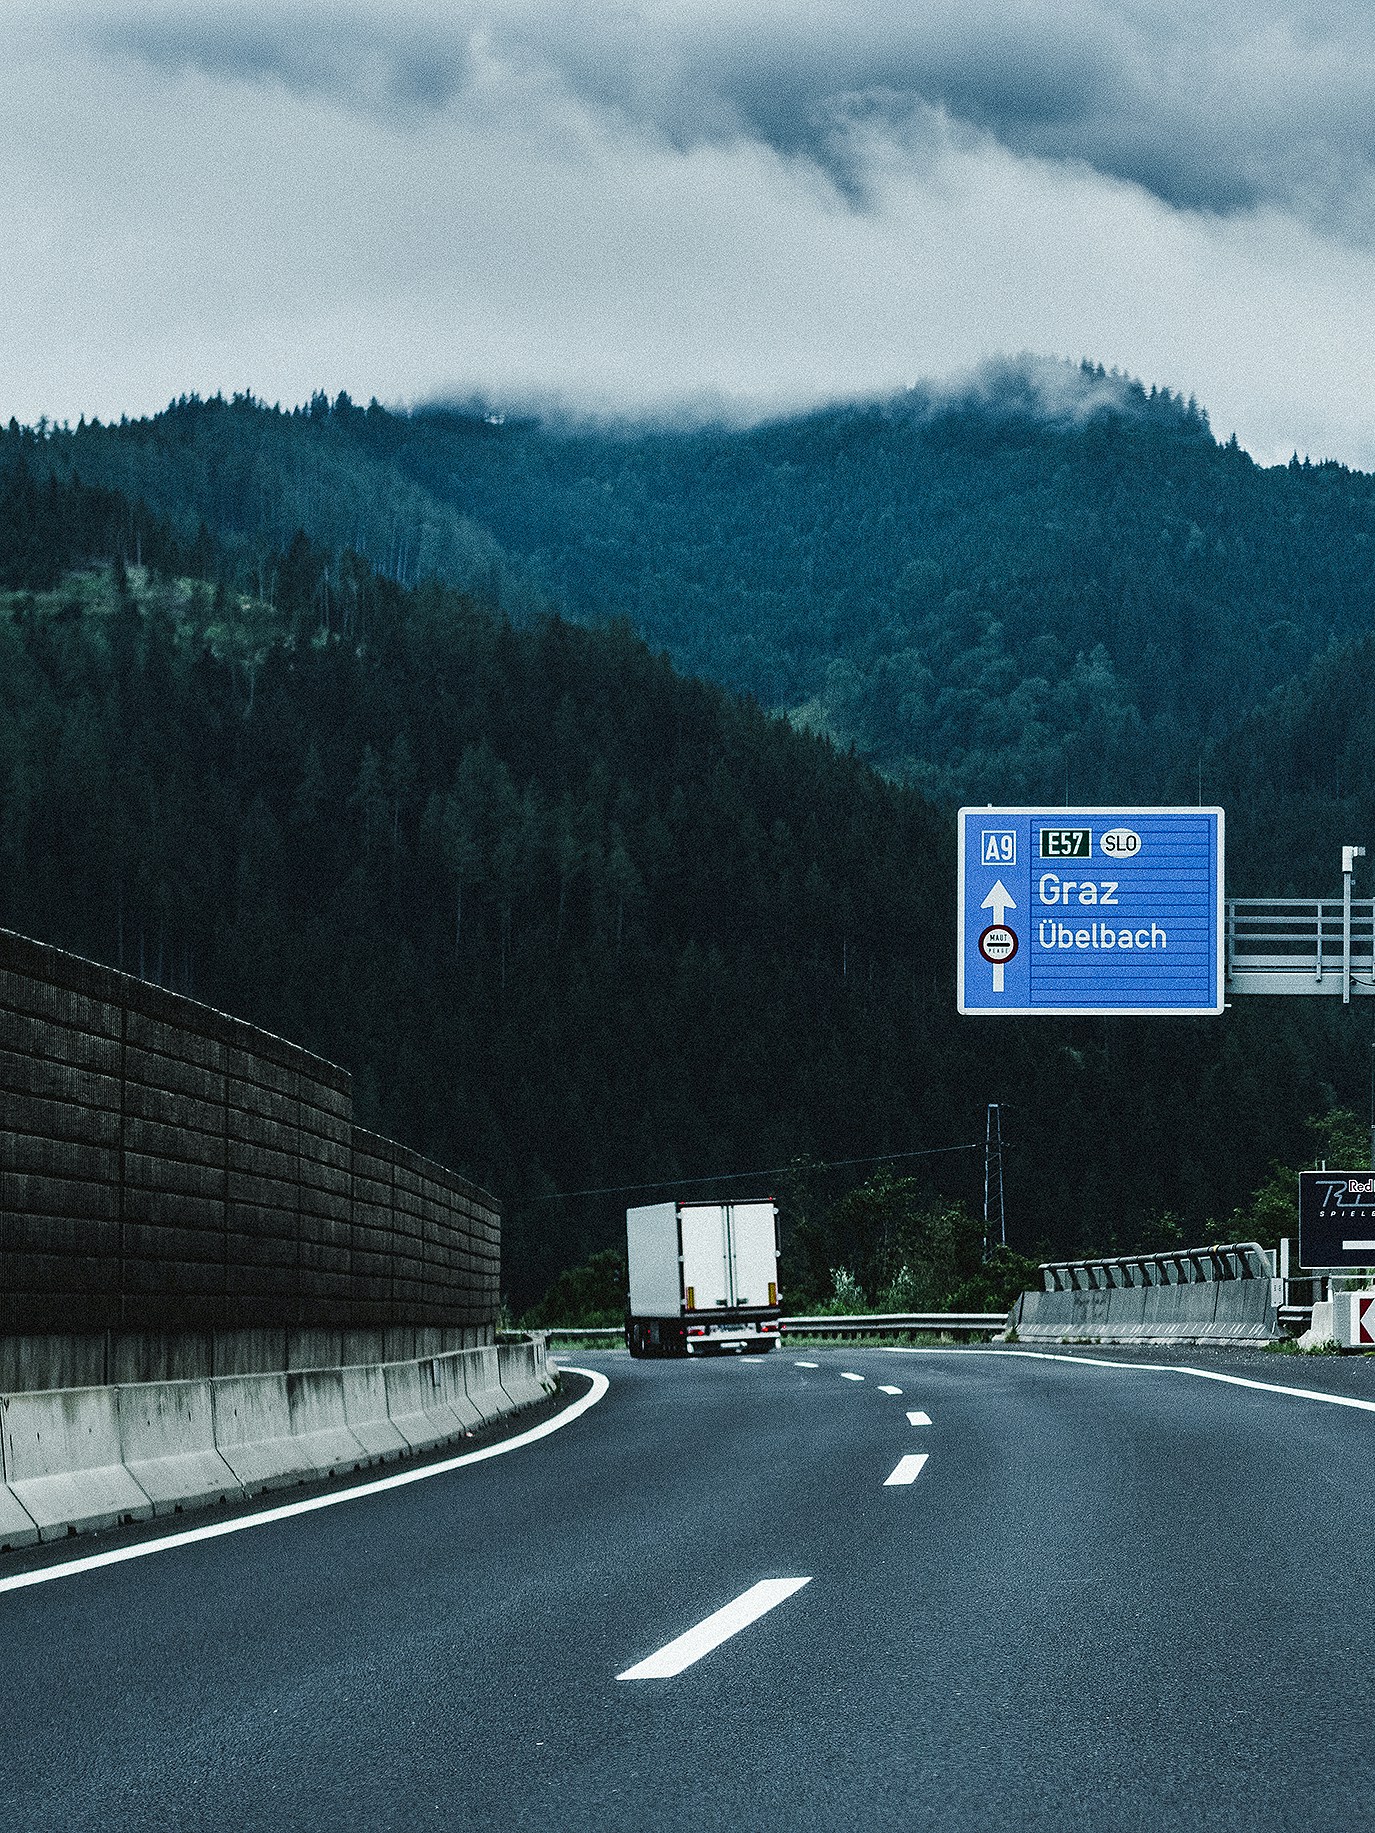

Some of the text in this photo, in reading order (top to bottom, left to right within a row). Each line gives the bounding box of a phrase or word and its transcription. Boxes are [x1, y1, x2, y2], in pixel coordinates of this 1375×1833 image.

[985, 835, 1013, 861] A9
[1048, 832, 1083, 855] E57
[1105, 835, 1137, 852] SLO
[1039, 873, 1119, 905] Graz
[1039, 919, 1167, 949] Übelbach
[1349, 1179, 1373, 1193] Red
